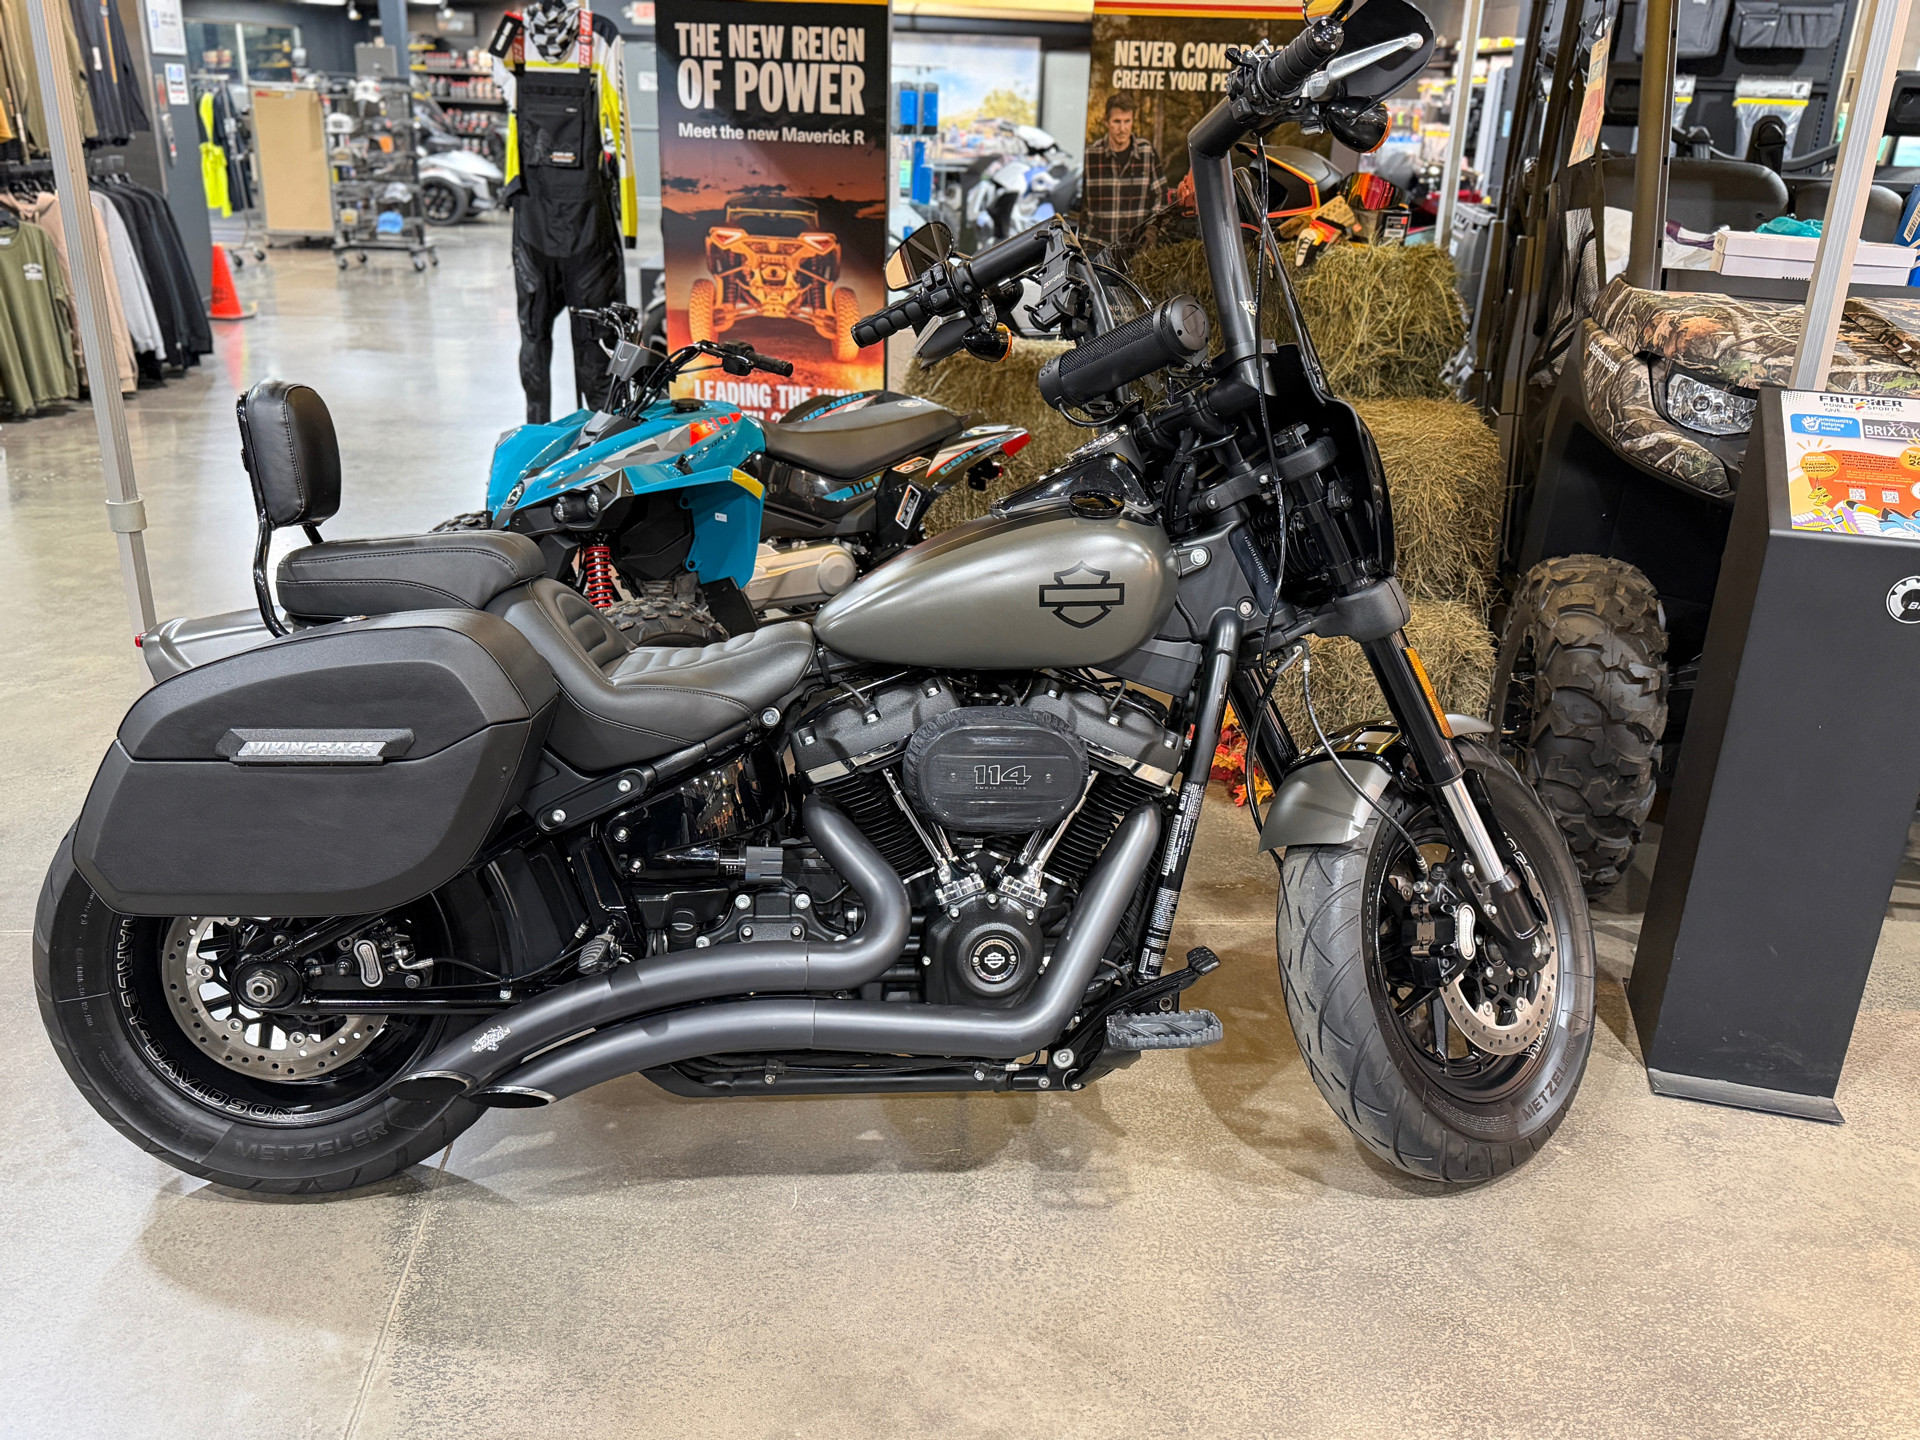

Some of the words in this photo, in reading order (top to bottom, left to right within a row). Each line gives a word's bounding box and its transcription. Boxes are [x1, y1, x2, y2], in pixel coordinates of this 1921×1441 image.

[674, 22, 722, 57] THE
[728, 24, 784, 59] NEW
[792, 26, 865, 62] REIGN
[1114, 40, 1177, 68] NEVER
[677, 58, 723, 109] OF
[735, 61, 865, 115] POWER
[1112, 69, 1165, 90] CREATE
[1169, 72, 1207, 92] YOUR
[678, 122, 717, 138] Meet
[719, 125, 744, 140] the
[747, 127, 779, 142] new
[782, 127, 850, 145] Maverick
[853, 130, 865, 145] R
[1588, 342, 1621, 374] DEFENDER
[694, 379, 772, 408] LEADING
[776, 385, 812, 410] THE
[1819, 395, 1903, 408] FALCONER
[1814, 416, 1853, 425] Community
[1865, 424, 1897, 436] BRIX
[250, 742, 373, 755] VIKINGBAGS
[974, 765, 1032, 785] 114
[1522, 1036, 1579, 1122] METZELER
[233, 1119, 390, 1160] METZELER
